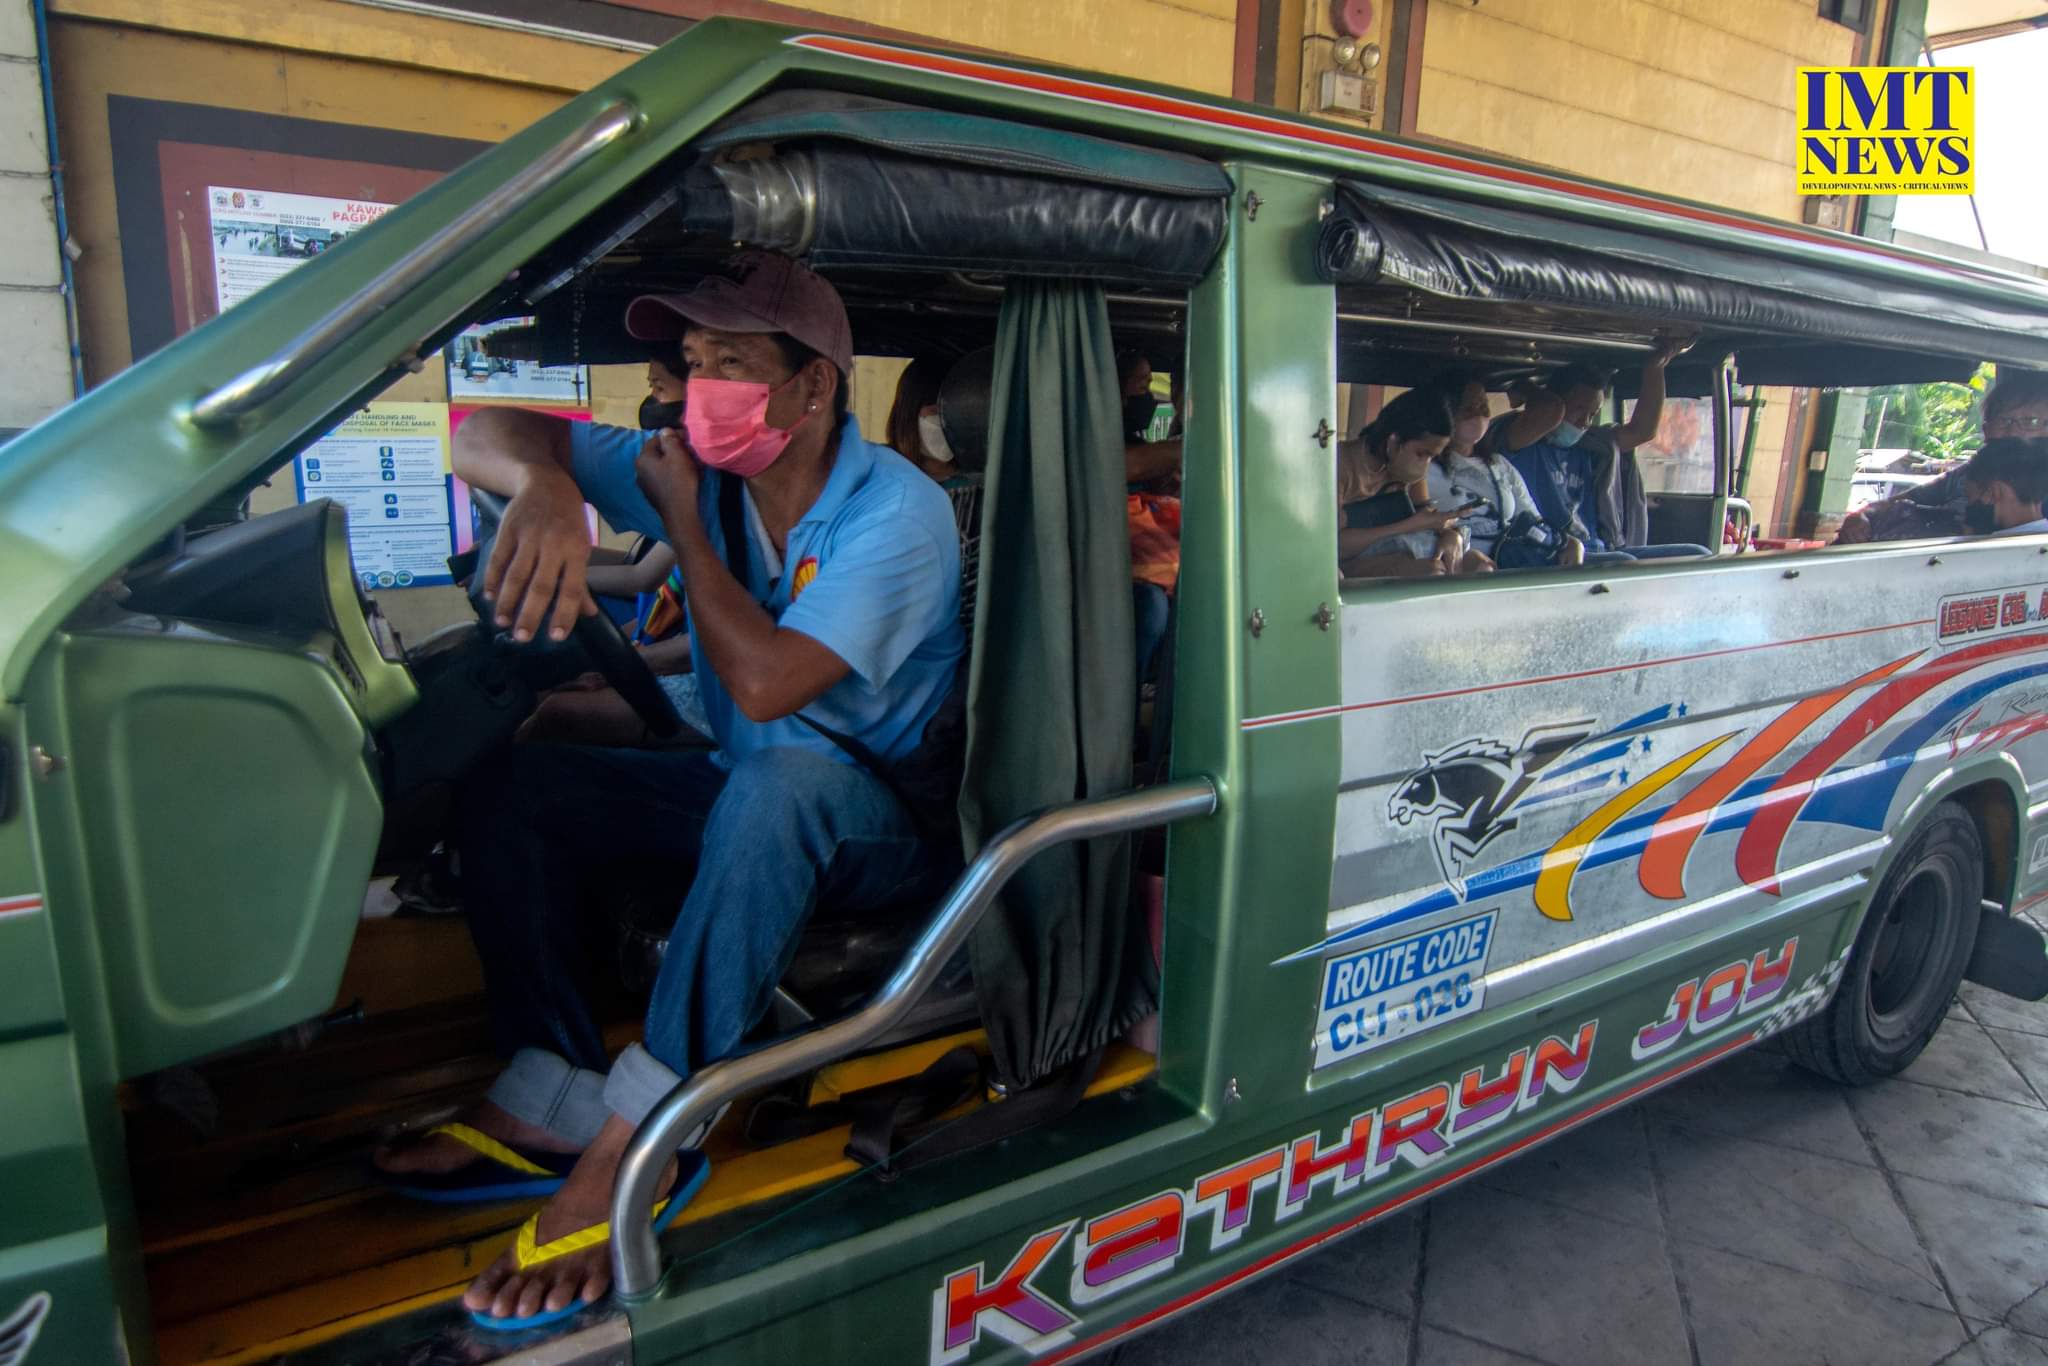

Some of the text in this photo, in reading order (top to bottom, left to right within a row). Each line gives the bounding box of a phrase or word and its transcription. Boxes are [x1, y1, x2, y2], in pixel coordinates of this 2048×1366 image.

[1332, 920, 1487, 1005] ROUTE CODE
[1631, 935, 1799, 1061] JOY
